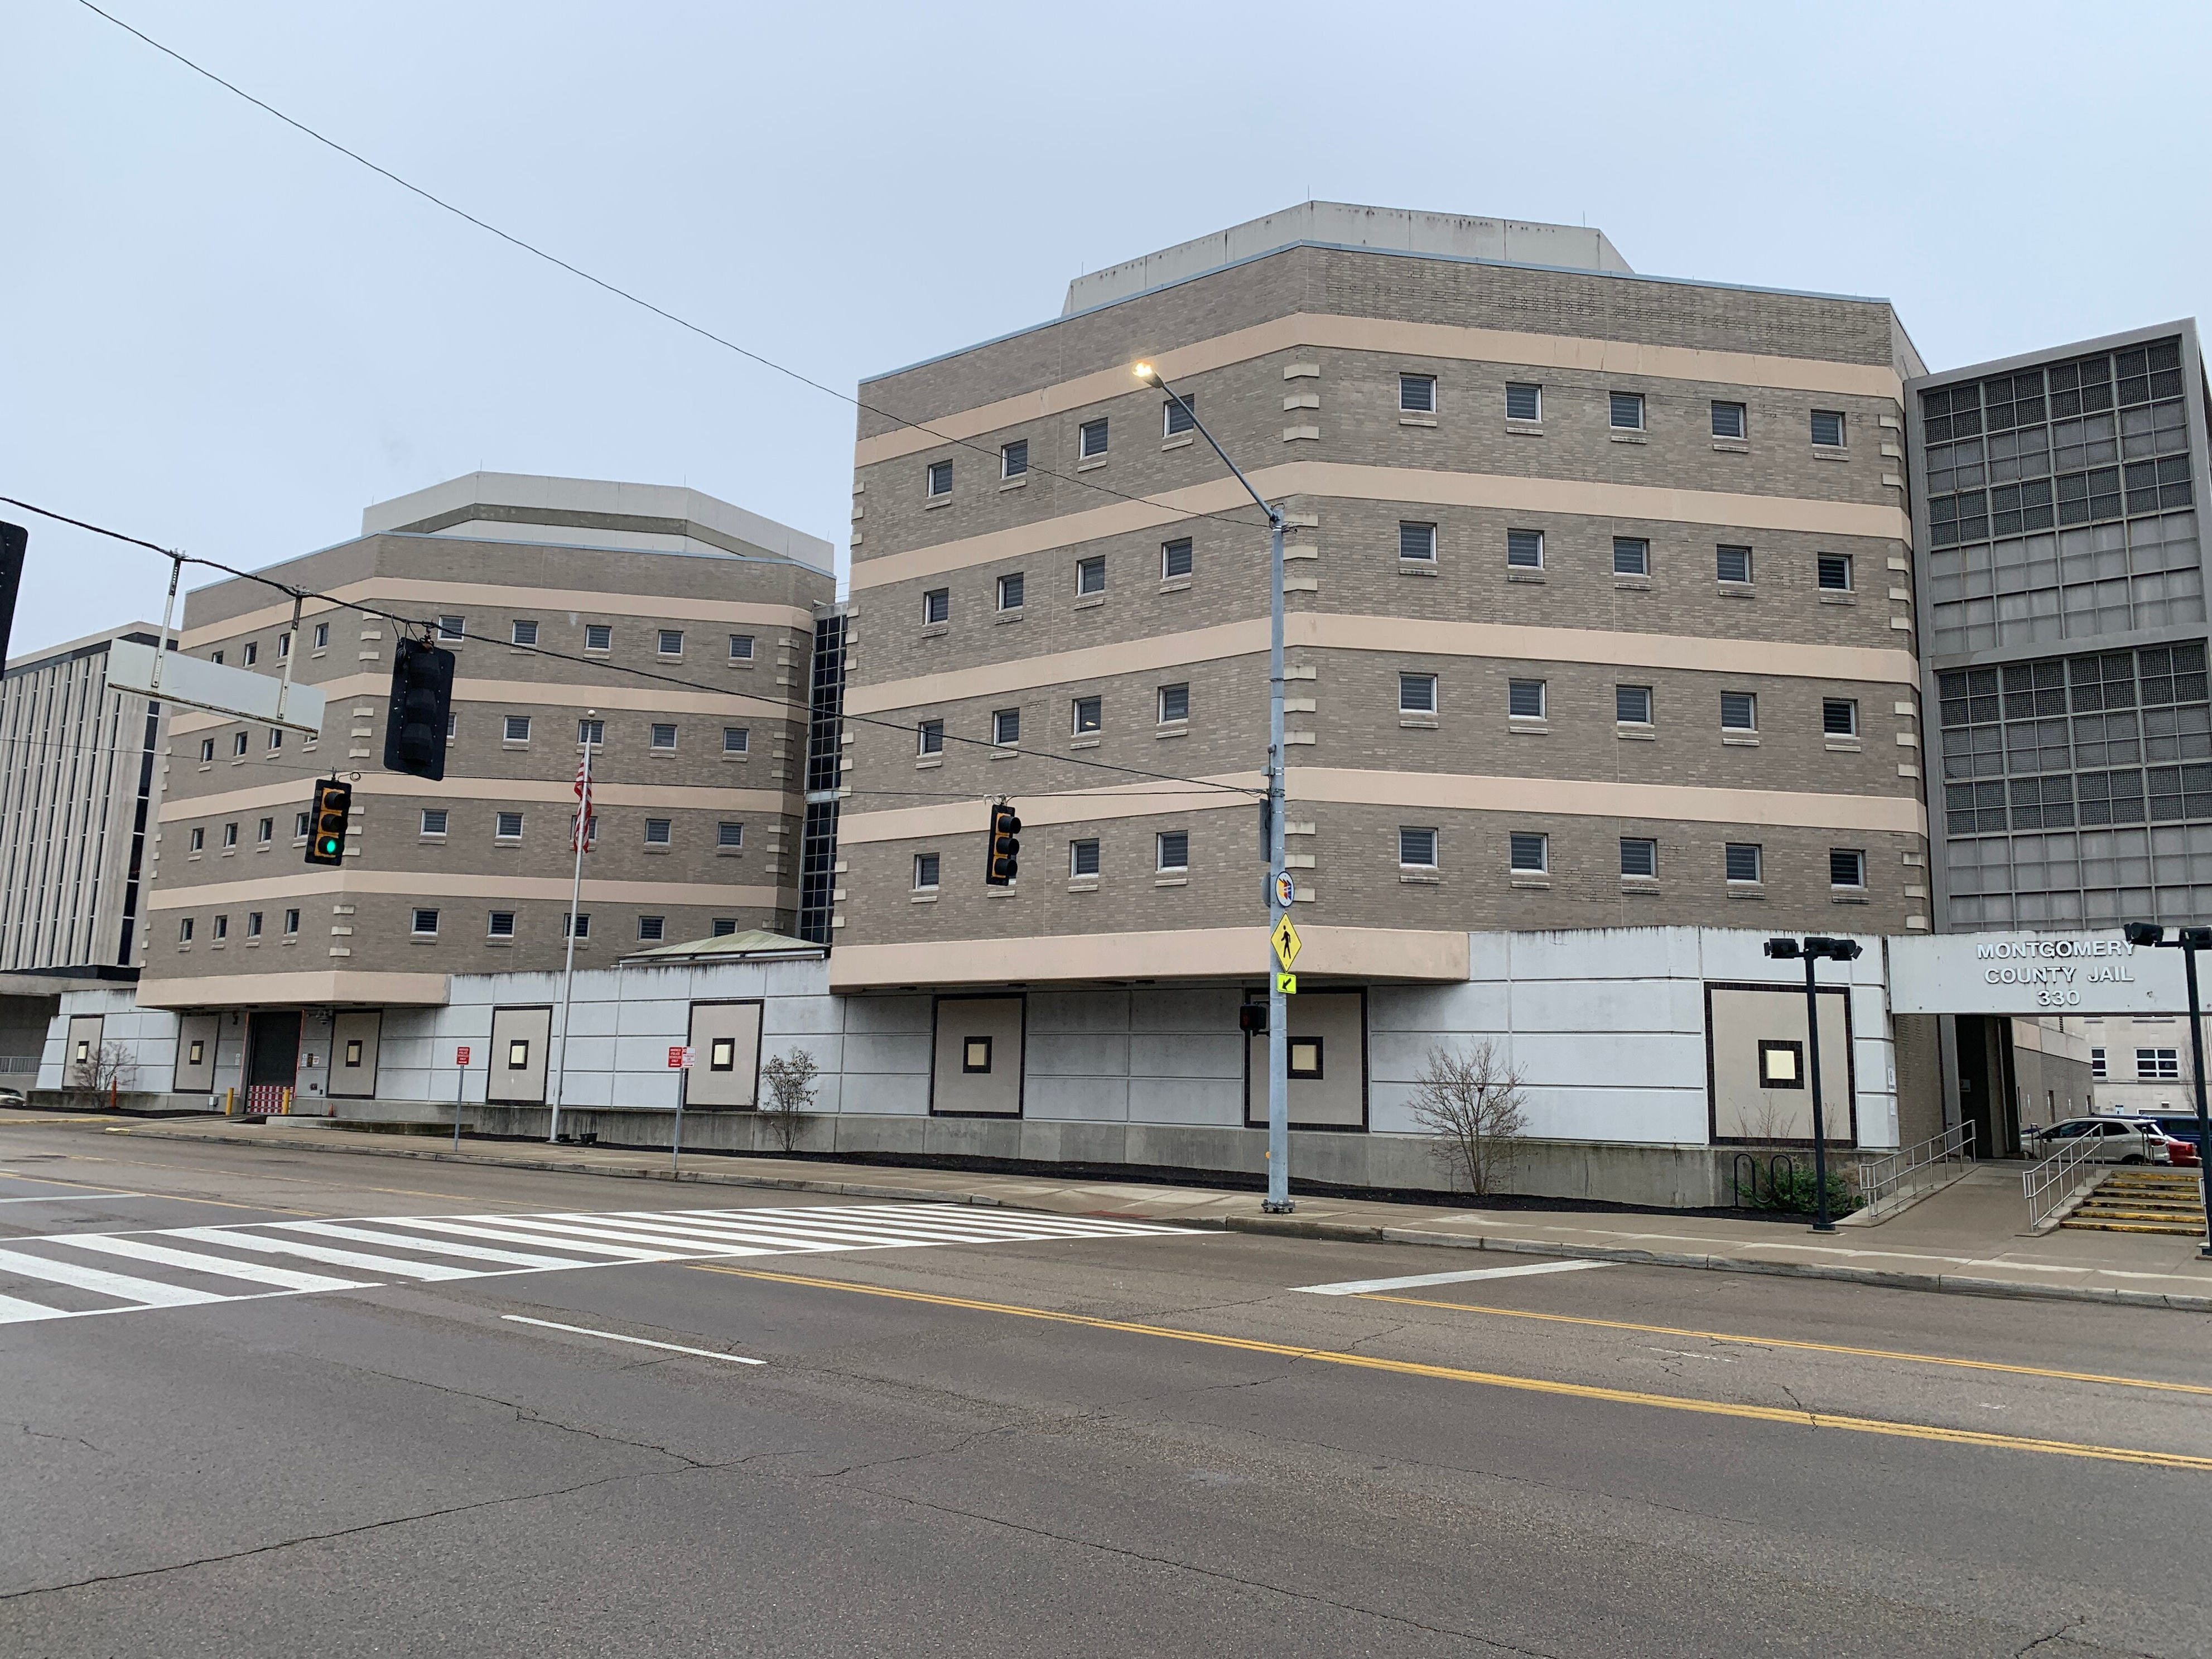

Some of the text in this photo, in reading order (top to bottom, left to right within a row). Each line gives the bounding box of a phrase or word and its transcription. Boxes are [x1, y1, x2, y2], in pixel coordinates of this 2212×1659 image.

[1977, 941, 2134, 958] MONTGOMERY
[1984, 966, 2134, 983] COUNTY JAIL
[2037, 990, 2080, 1006] 330
